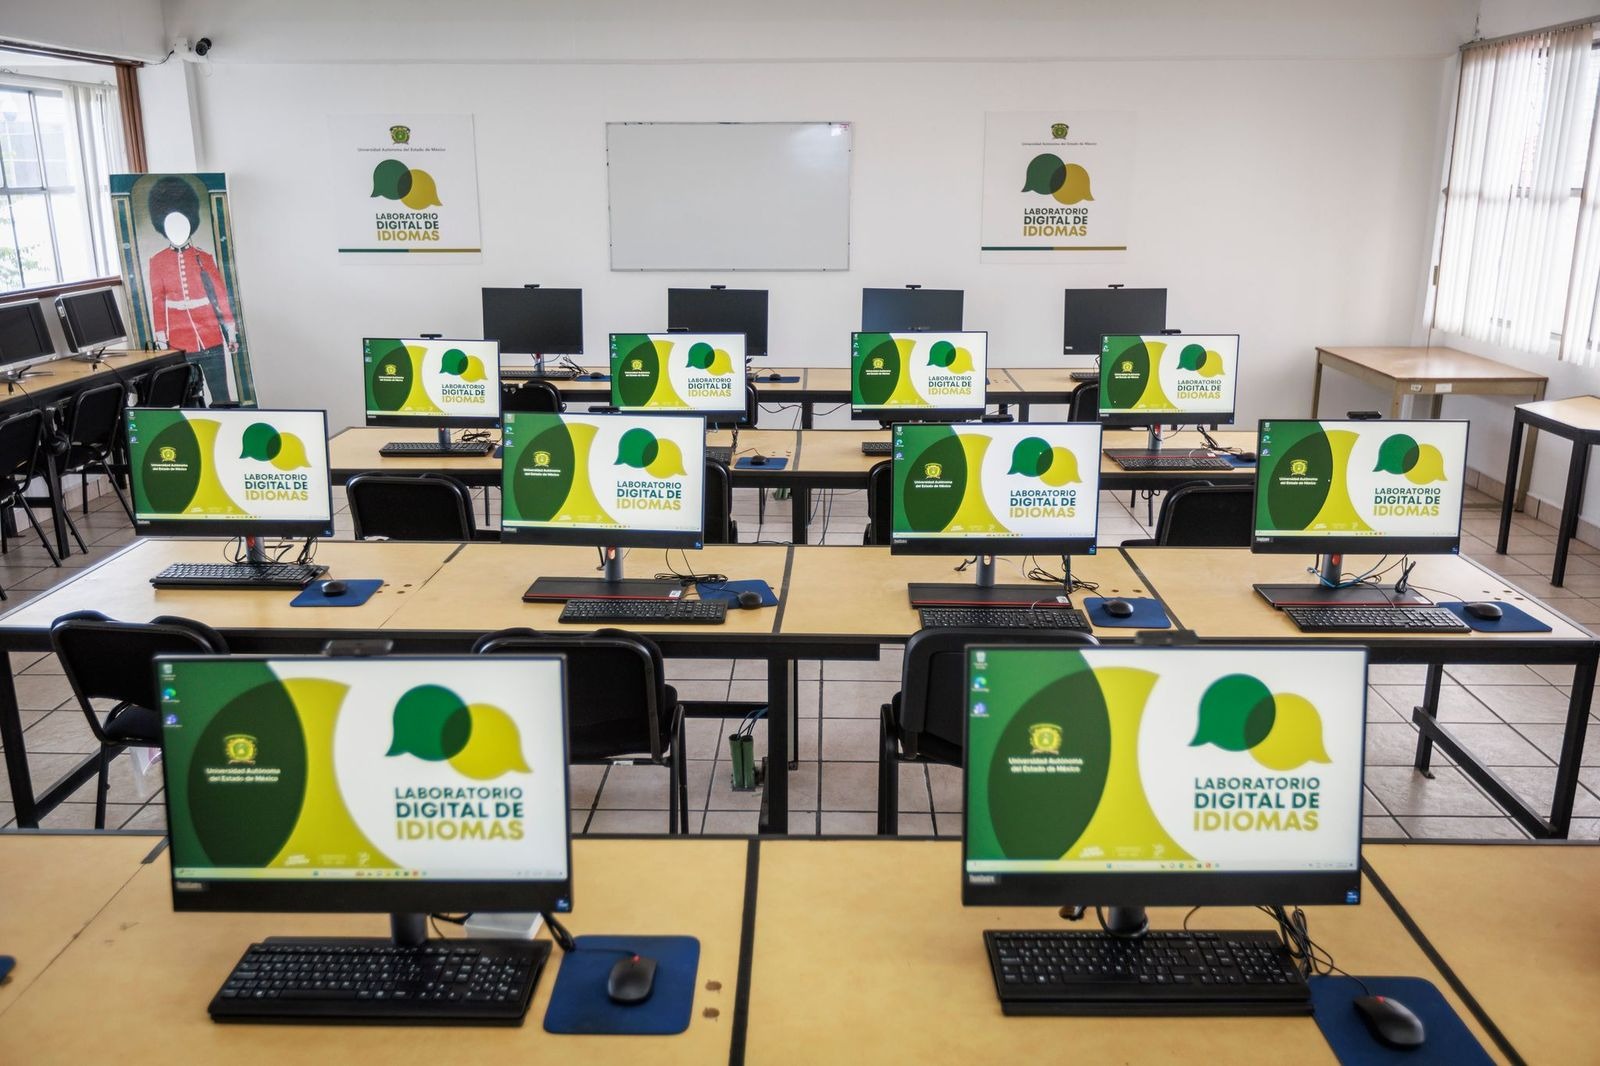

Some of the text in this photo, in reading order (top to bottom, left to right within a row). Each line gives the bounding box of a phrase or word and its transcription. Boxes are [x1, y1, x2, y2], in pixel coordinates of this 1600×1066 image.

[377, 221, 439, 229] DIGITAL DE
[1024, 216, 1087, 225] DIGITAL DE
[378, 230, 439, 241] IDIOMAS
[1024, 226, 1087, 236] IDIOMAS
[245, 481, 307, 489] DIGITAL DE
[617, 481, 682, 489] LABORATORIO
[245, 490, 308, 500] IDIOMAS
[617, 489, 682, 499] DIGITAL DE
[617, 499, 682, 510] IDIOMAS
[1010, 498, 1075, 506] DIGITAL DE
[1375, 496, 1440, 504] DIGITAL DE
[1010, 507, 1075, 517] IDIOMAS
[1374, 505, 1439, 516] IDIOMAS
[1195, 778, 1320, 790] LABORATORIO
[396, 788, 522, 799] LABORATORIO
[1195, 793, 1319, 809] DIGITAL DE
[396, 802, 523, 818] DIGITAL DE
[1194, 811, 1319, 831] IDIOMAS
[397, 820, 523, 840] IDIOMAS
